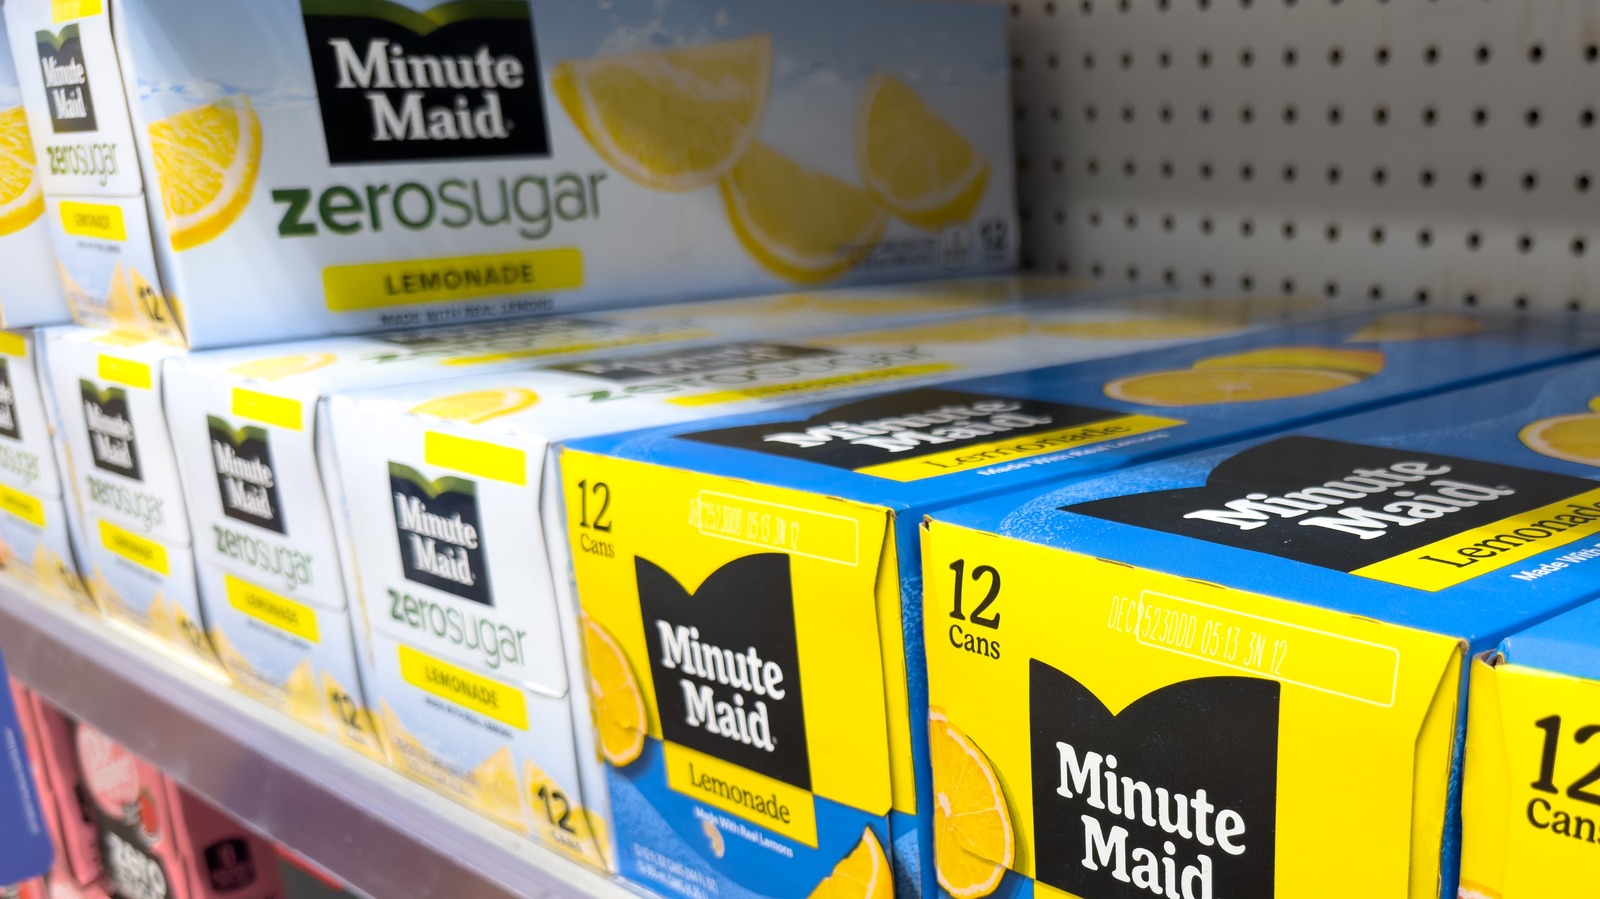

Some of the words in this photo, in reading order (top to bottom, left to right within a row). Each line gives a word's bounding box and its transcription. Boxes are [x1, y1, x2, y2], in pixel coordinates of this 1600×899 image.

[41, 55, 86, 88] Minute
[328, 38, 525, 89] Minute
[51, 86, 87, 120] Maid
[365, 90, 512, 141] Maid
[46, 142, 119, 187] zerosugar
[271, 170, 608, 241] zerosugar
[384, 261, 535, 296] LEMONADE
[763, 400, 1021, 448] Minute
[850, 411, 1053, 453] Maid
[922, 425, 1131, 469] Lemonade
[212, 438, 274, 489] Minute
[225, 475, 275, 520] Maid
[578, 479, 612, 534] 12
[1183, 460, 1453, 530] Minute
[1297, 479, 1515, 541] Maid
[396, 492, 479, 550] Minute
[580, 532, 615, 560] Cans
[212, 522, 315, 591] zerosugar
[408, 534, 475, 587] Maid
[1510, 561, 1569, 582] Made
[948, 558, 1001, 631] 12
[387, 585, 528, 670] zerosugar
[948, 623, 1001, 660] Cans
[655, 619, 786, 701] Minute
[1244, 632, 1267, 669] 3N
[1269, 640, 1288, 676] 12
[425, 665, 501, 710] LEMONADE
[679, 678, 776, 753] Maid
[1529, 714, 1600, 807] 12
[537, 785, 577, 835] 12
[689, 762, 792, 826] Lemonade
[1056, 741, 1246, 856] Minute
[1527, 797, 1600, 845] Can
[1080, 814, 1213, 899] Maid
